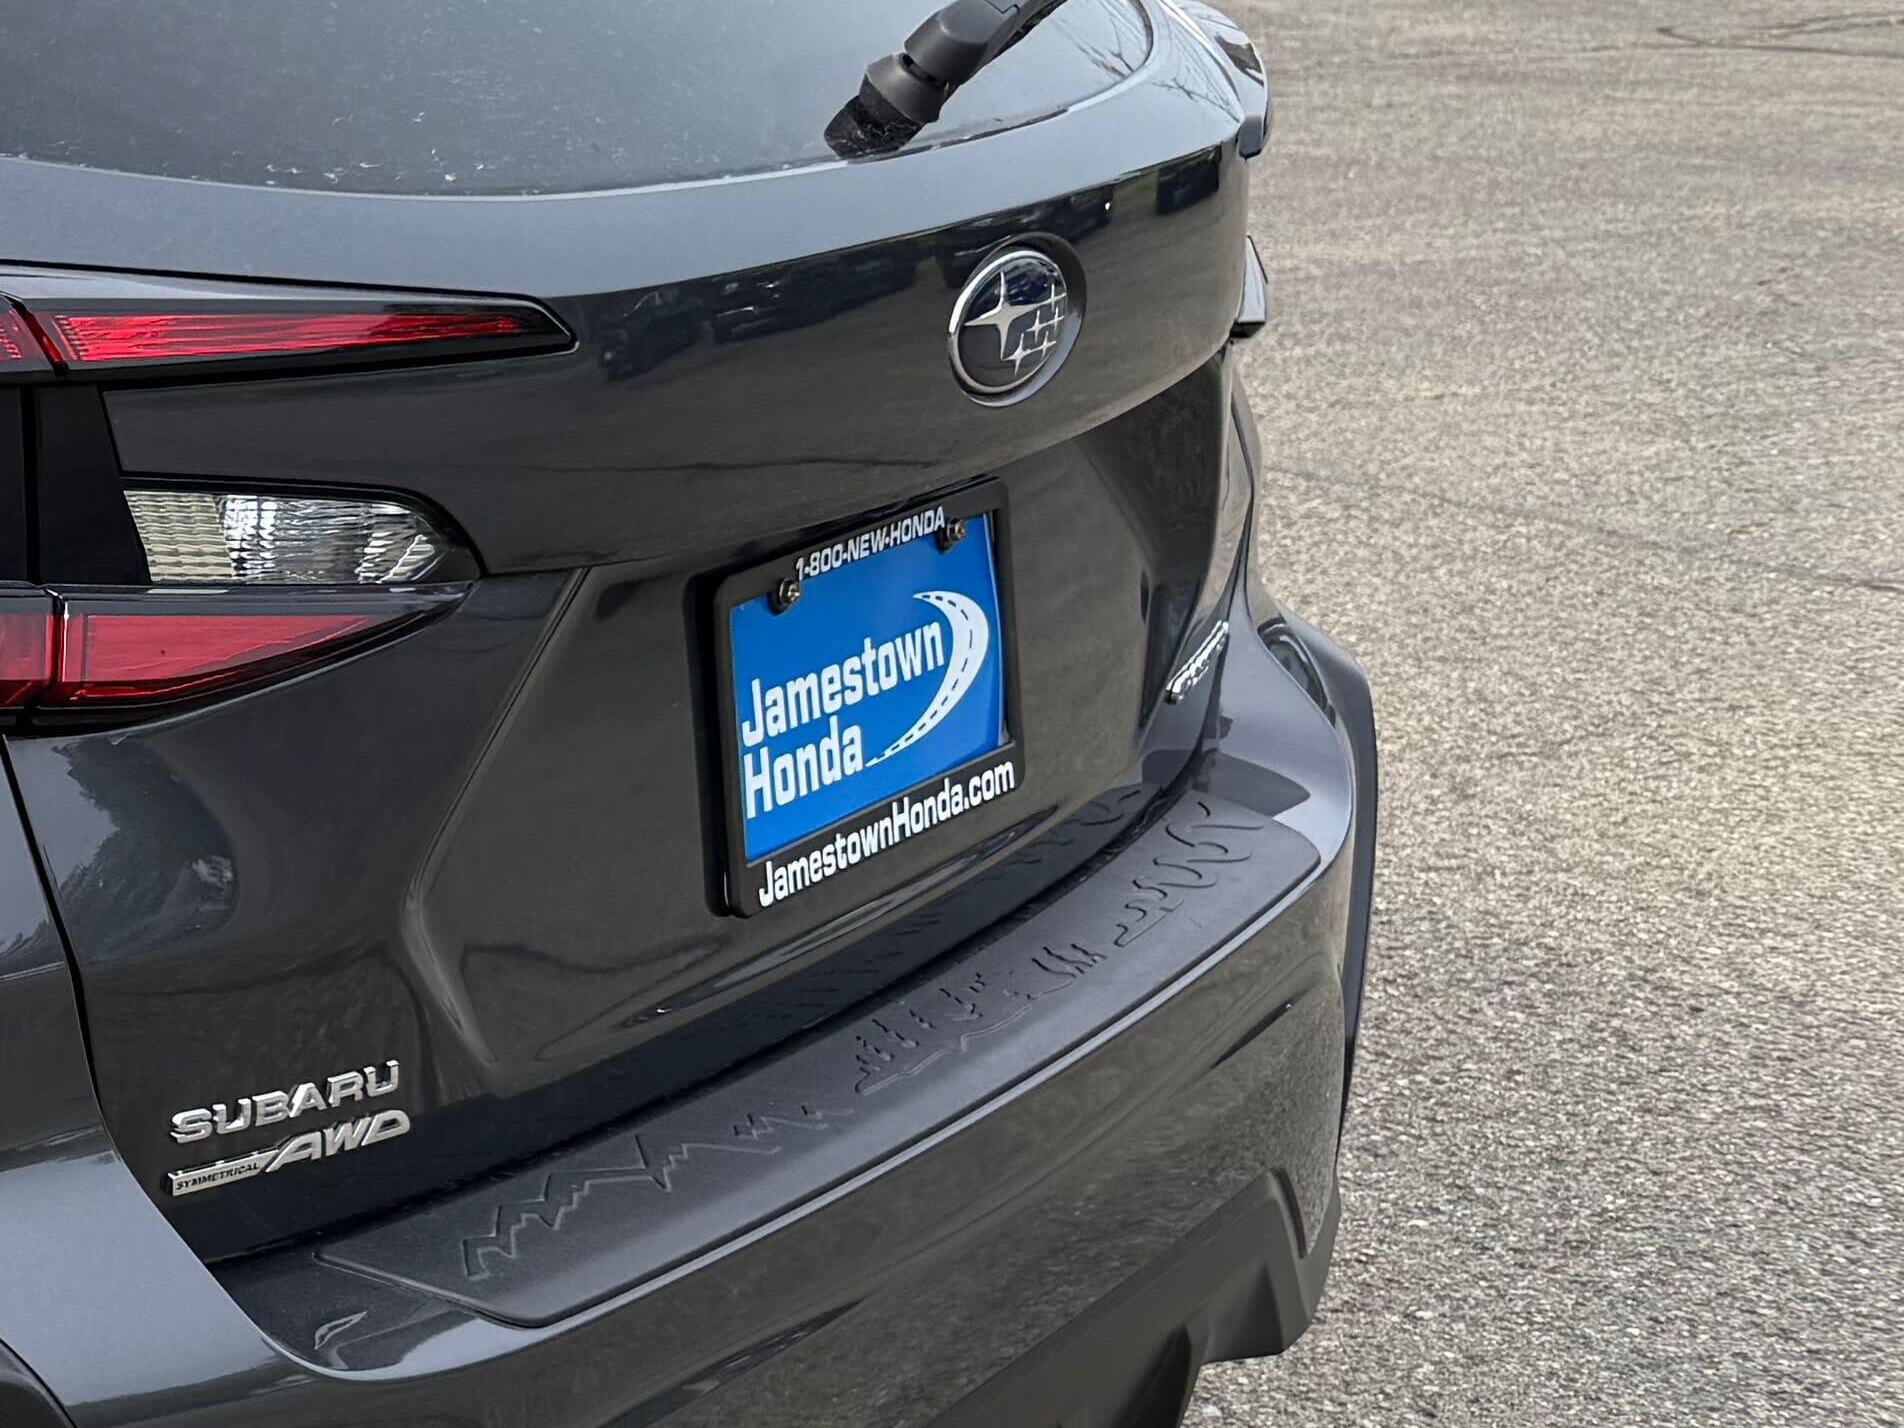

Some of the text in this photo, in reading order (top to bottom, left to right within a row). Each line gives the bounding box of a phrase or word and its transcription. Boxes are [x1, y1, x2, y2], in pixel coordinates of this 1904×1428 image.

[795, 506, 945, 581] 1-800-NEW-HONDA
[741, 620, 944, 747] Jamestown
[743, 716, 865, 819] Honda
[758, 761, 1016, 907] JamestownHonda.com
[169, 1059, 401, 1144] SUBARU
[175, 1108, 411, 1191] SYMMETRICAL AWD
